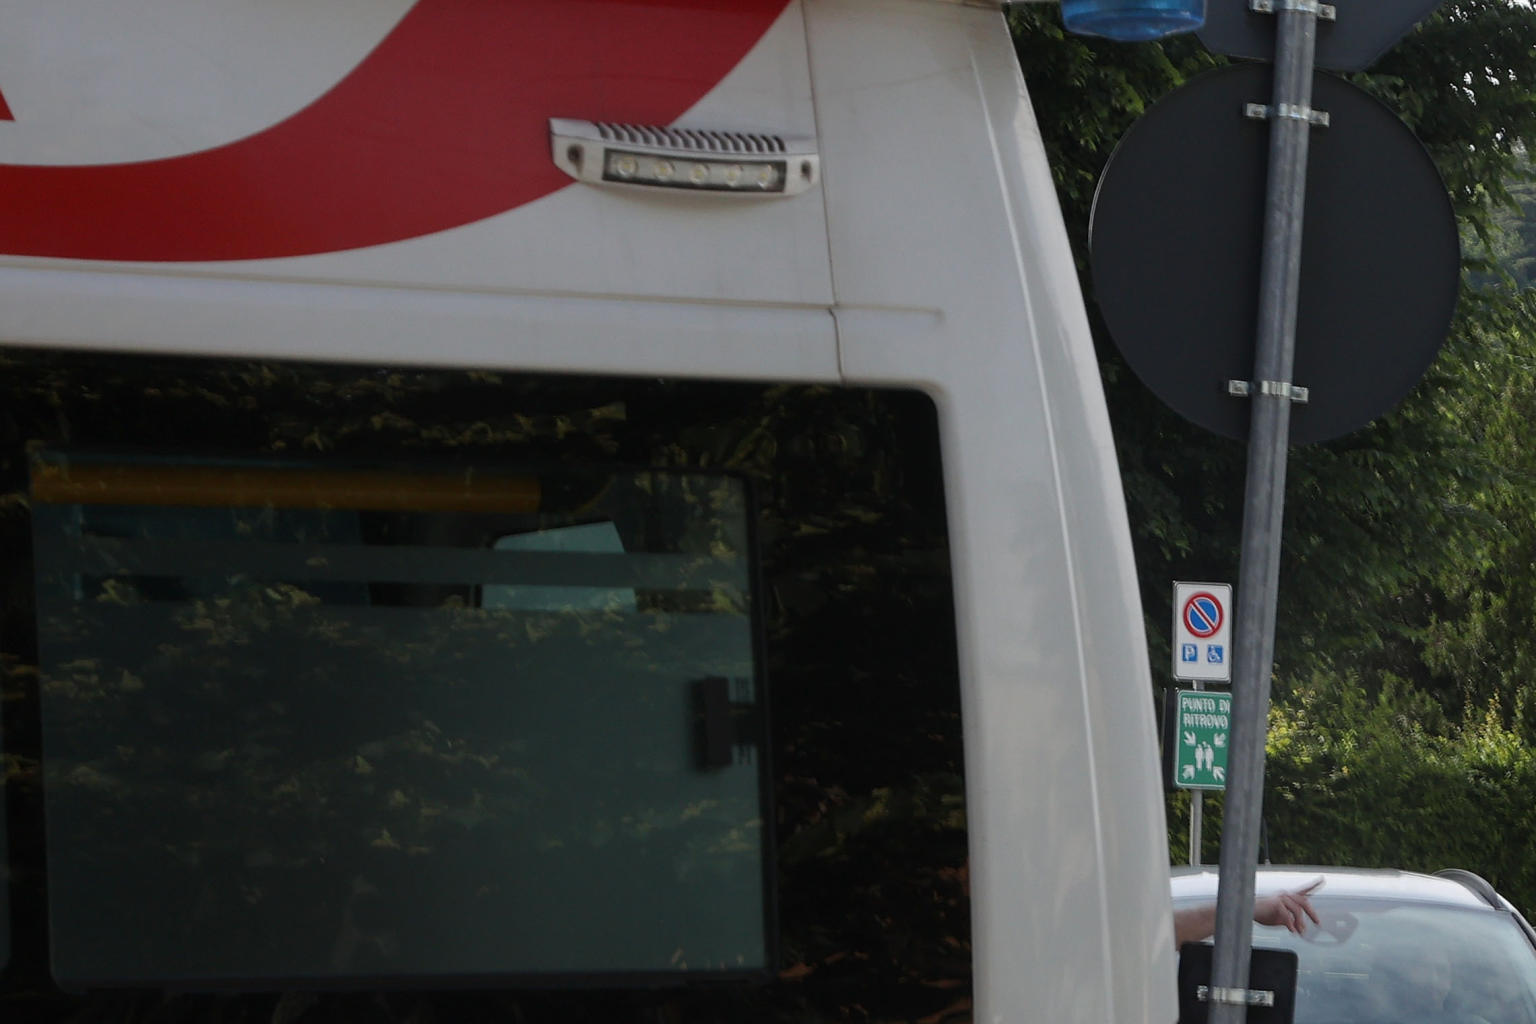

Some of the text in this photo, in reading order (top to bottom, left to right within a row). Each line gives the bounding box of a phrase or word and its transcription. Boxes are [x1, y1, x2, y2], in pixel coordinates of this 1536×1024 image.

[1182, 697, 1231, 714] PUNTO DI
[1183, 713, 1229, 730] RITROVO
